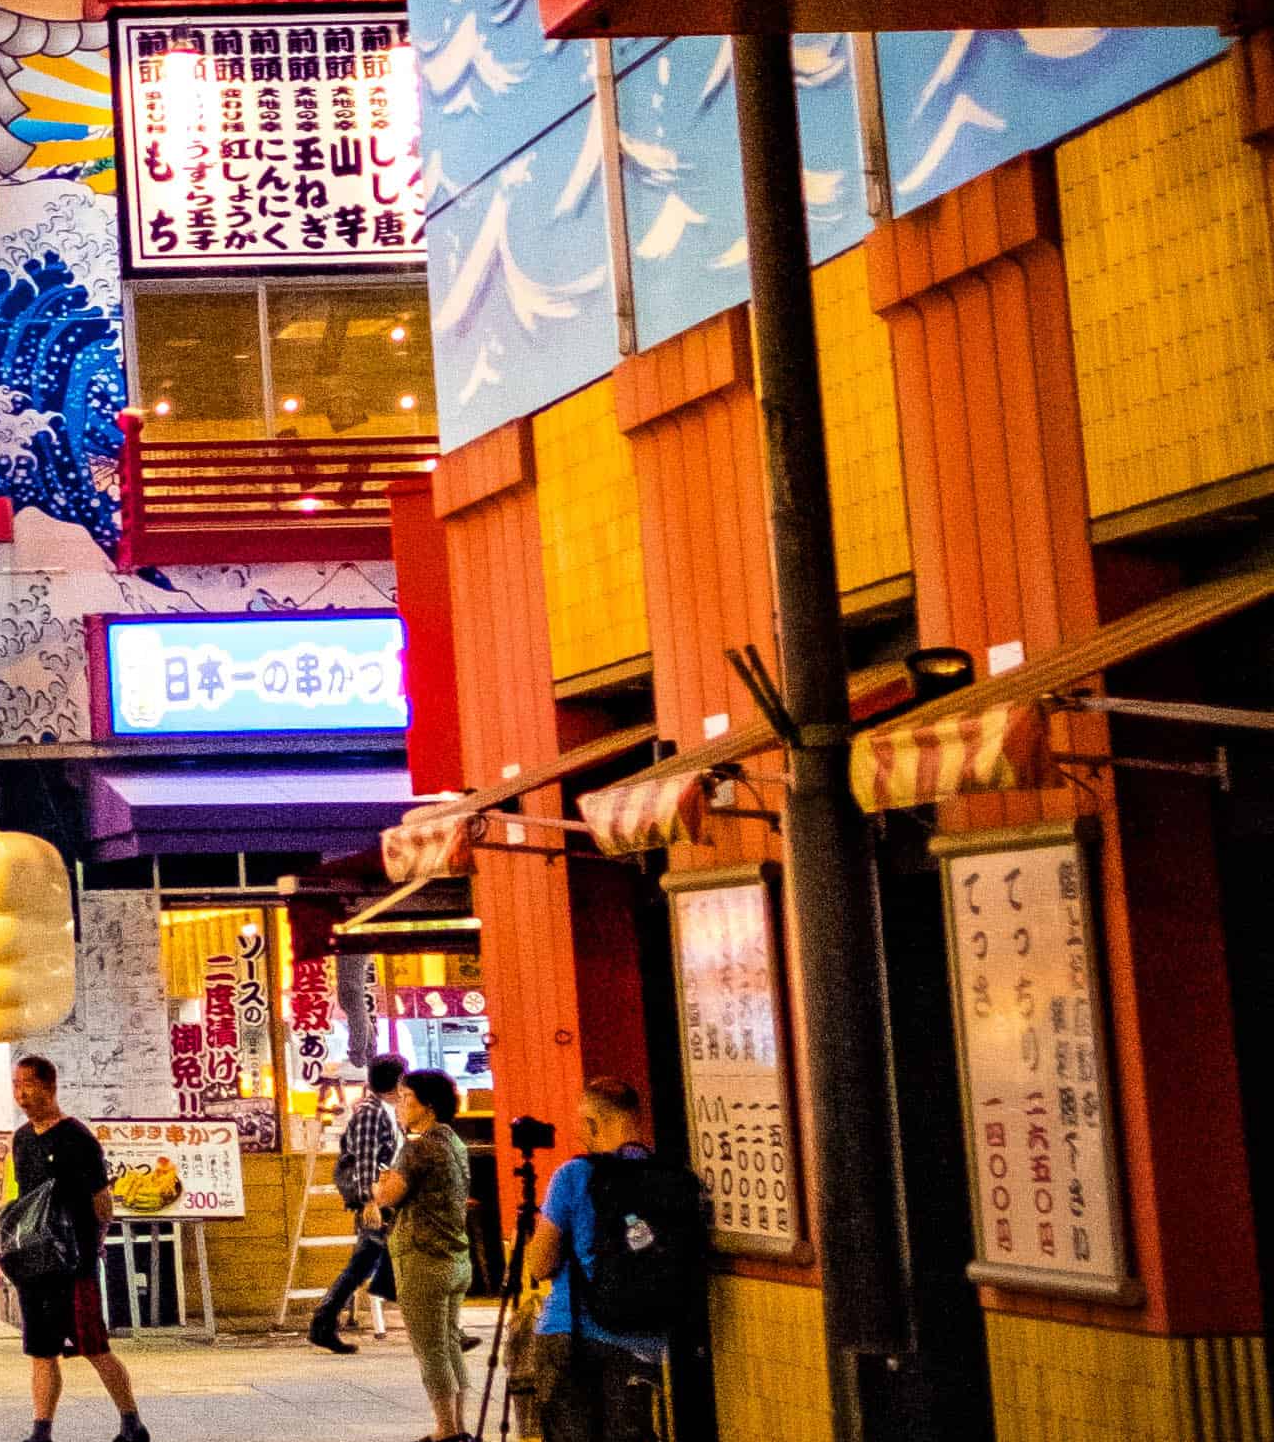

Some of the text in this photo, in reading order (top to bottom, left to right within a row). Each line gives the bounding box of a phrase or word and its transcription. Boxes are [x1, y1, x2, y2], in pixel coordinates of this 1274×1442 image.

[218, 138, 259, 251] 紅しょうが
[254, 138, 290, 251] にんにく
[293, 136, 332, 250] 玉ねぎ
[330, 135, 368, 249] 山芋
[369, 134, 407, 247] しし唐
[163, 654, 387, 705] 日本一の串かつ
[205, 954, 239, 1084] 二度漬け
[238, 934, 266, 1025] ソースの
[292, 962, 331, 1087] 座敷あり
[184, 1192, 219, 1210] 300
